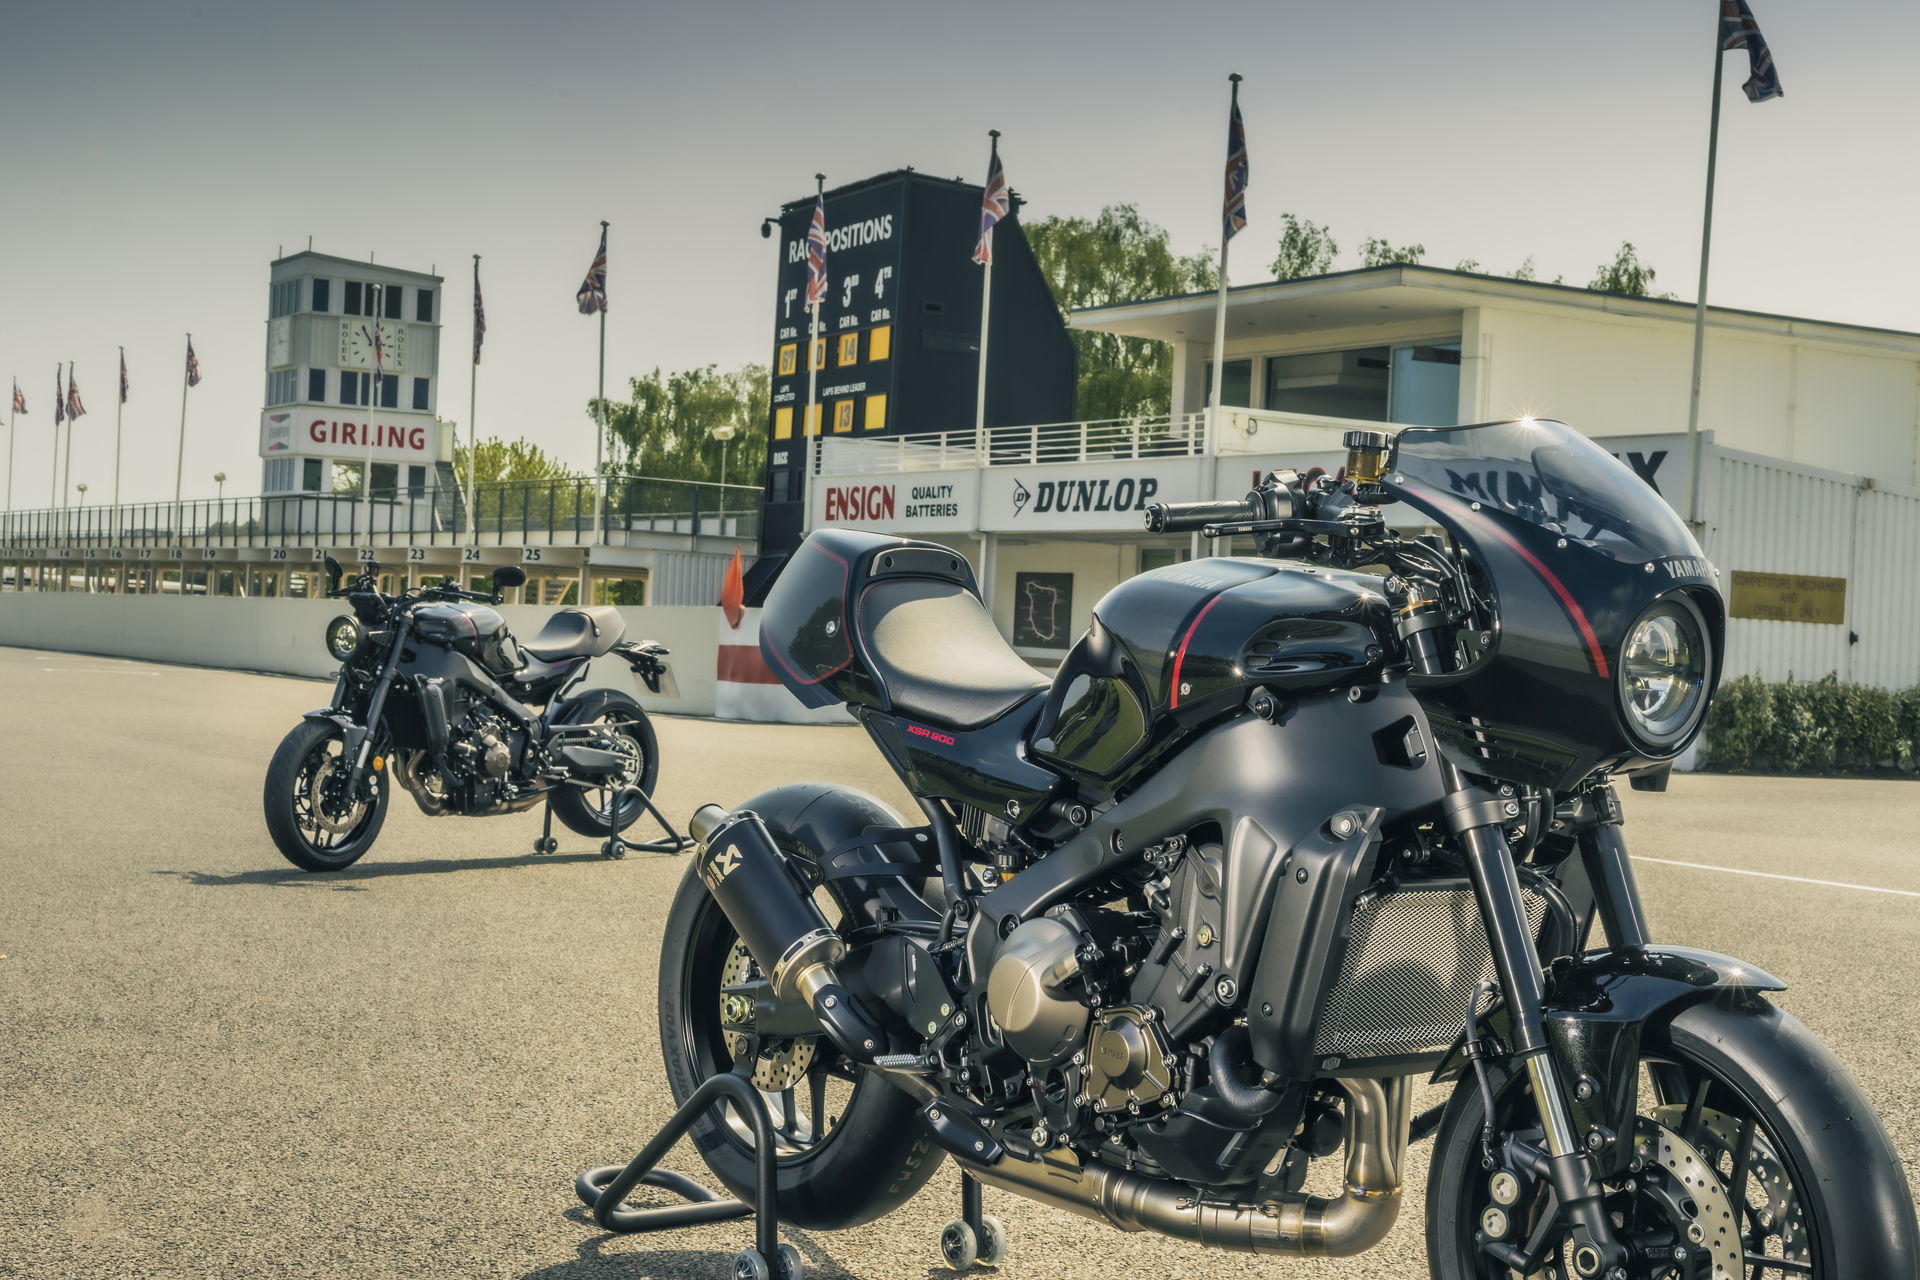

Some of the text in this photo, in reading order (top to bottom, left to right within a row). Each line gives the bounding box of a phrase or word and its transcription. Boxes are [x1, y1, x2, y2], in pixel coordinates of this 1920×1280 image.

[824, 214, 893, 252] POSITIONS
[309, 420, 425, 450] GIRLING
[911, 485, 953, 500] QUALITY
[1033, 478, 1158, 513] DUNLOP
[825, 485, 895, 521] ENSIGN
[905, 503, 958, 518] BATTERIES
[25, 550, 34, 558] 12
[60, 550, 70, 558] 14
[85, 550, 95, 558] 15
[111, 550, 122, 559] 16
[140, 550, 150, 559] 17
[171, 550, 182, 559] 18
[204, 550, 215, 559] 19
[273, 550, 286, 560] 20
[315, 550, 328, 560] 21
[360, 550, 374, 560] 22
[410, 550, 425, 560] 23
[465, 550, 480, 560] 24
[525, 550, 541, 560] 25
[907, 724, 955, 745] XSR 900
